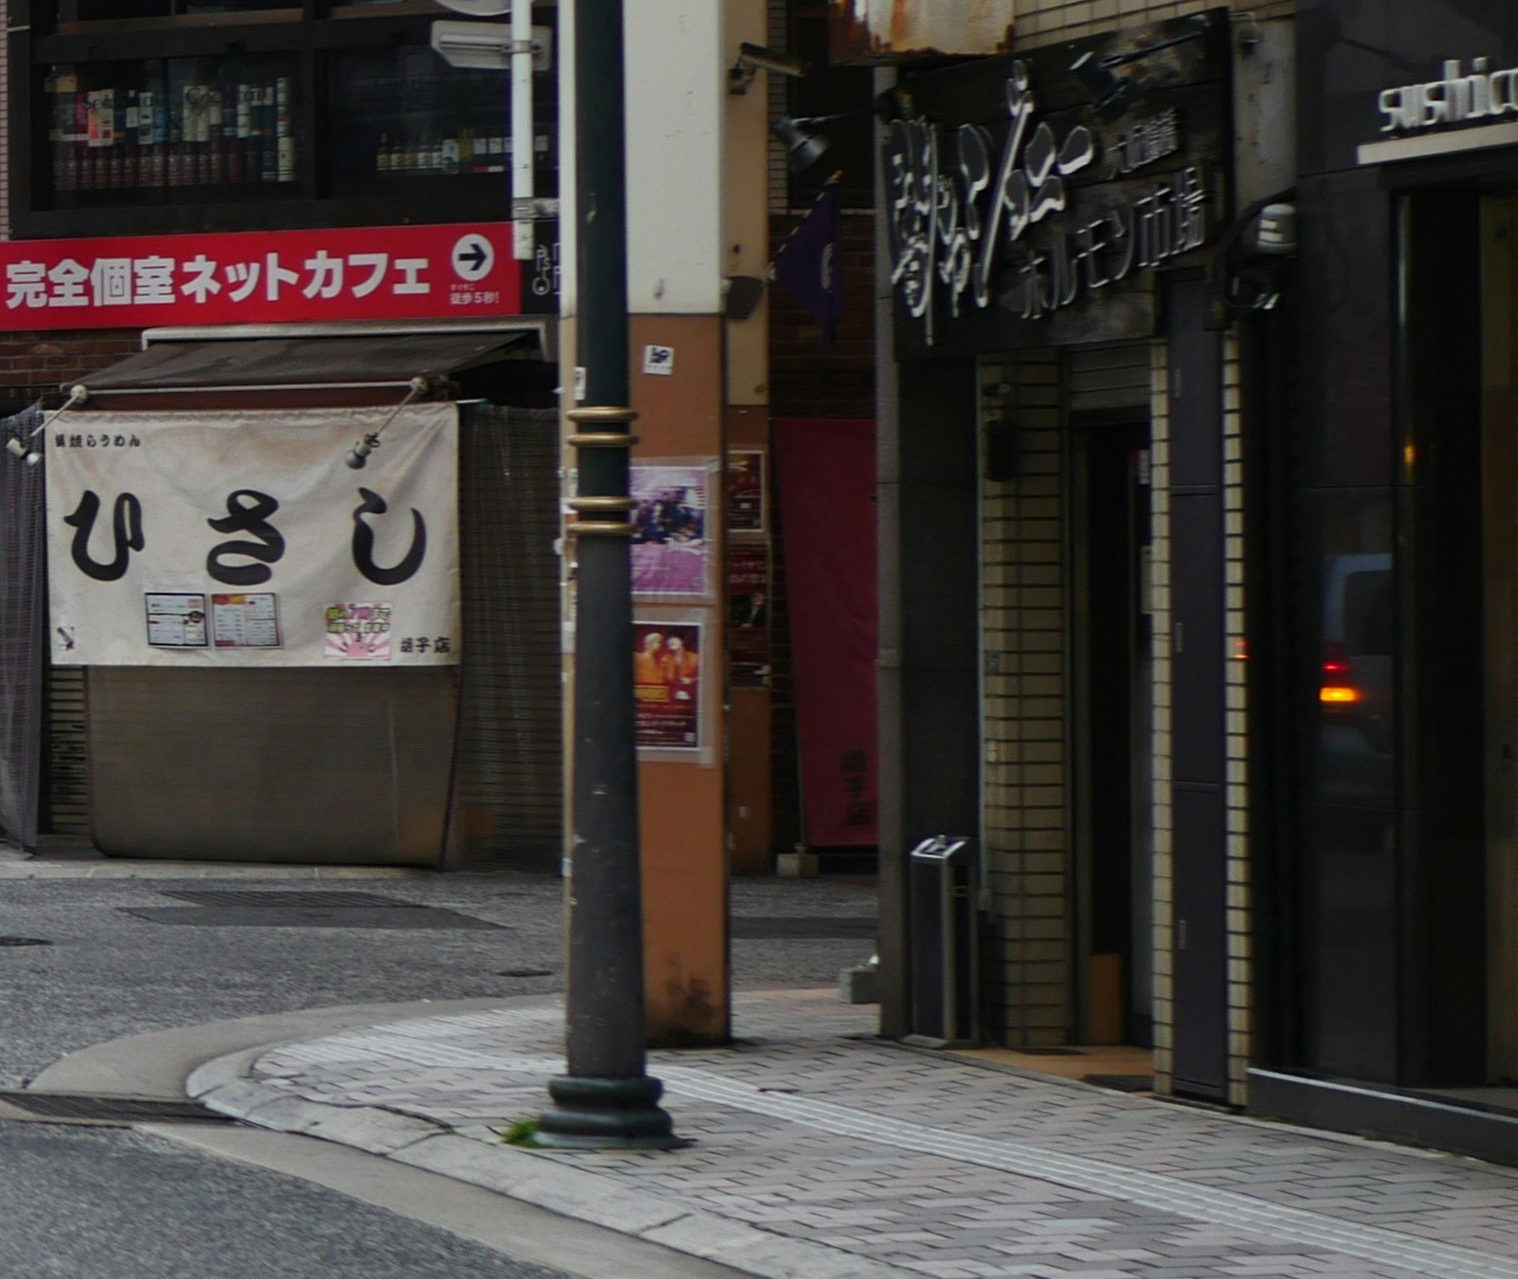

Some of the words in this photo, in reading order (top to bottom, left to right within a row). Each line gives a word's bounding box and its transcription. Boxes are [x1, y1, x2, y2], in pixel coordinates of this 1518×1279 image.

[4, 250, 431, 310] 完全個室ネットカフェ
[63, 486, 427, 587] ひさし
